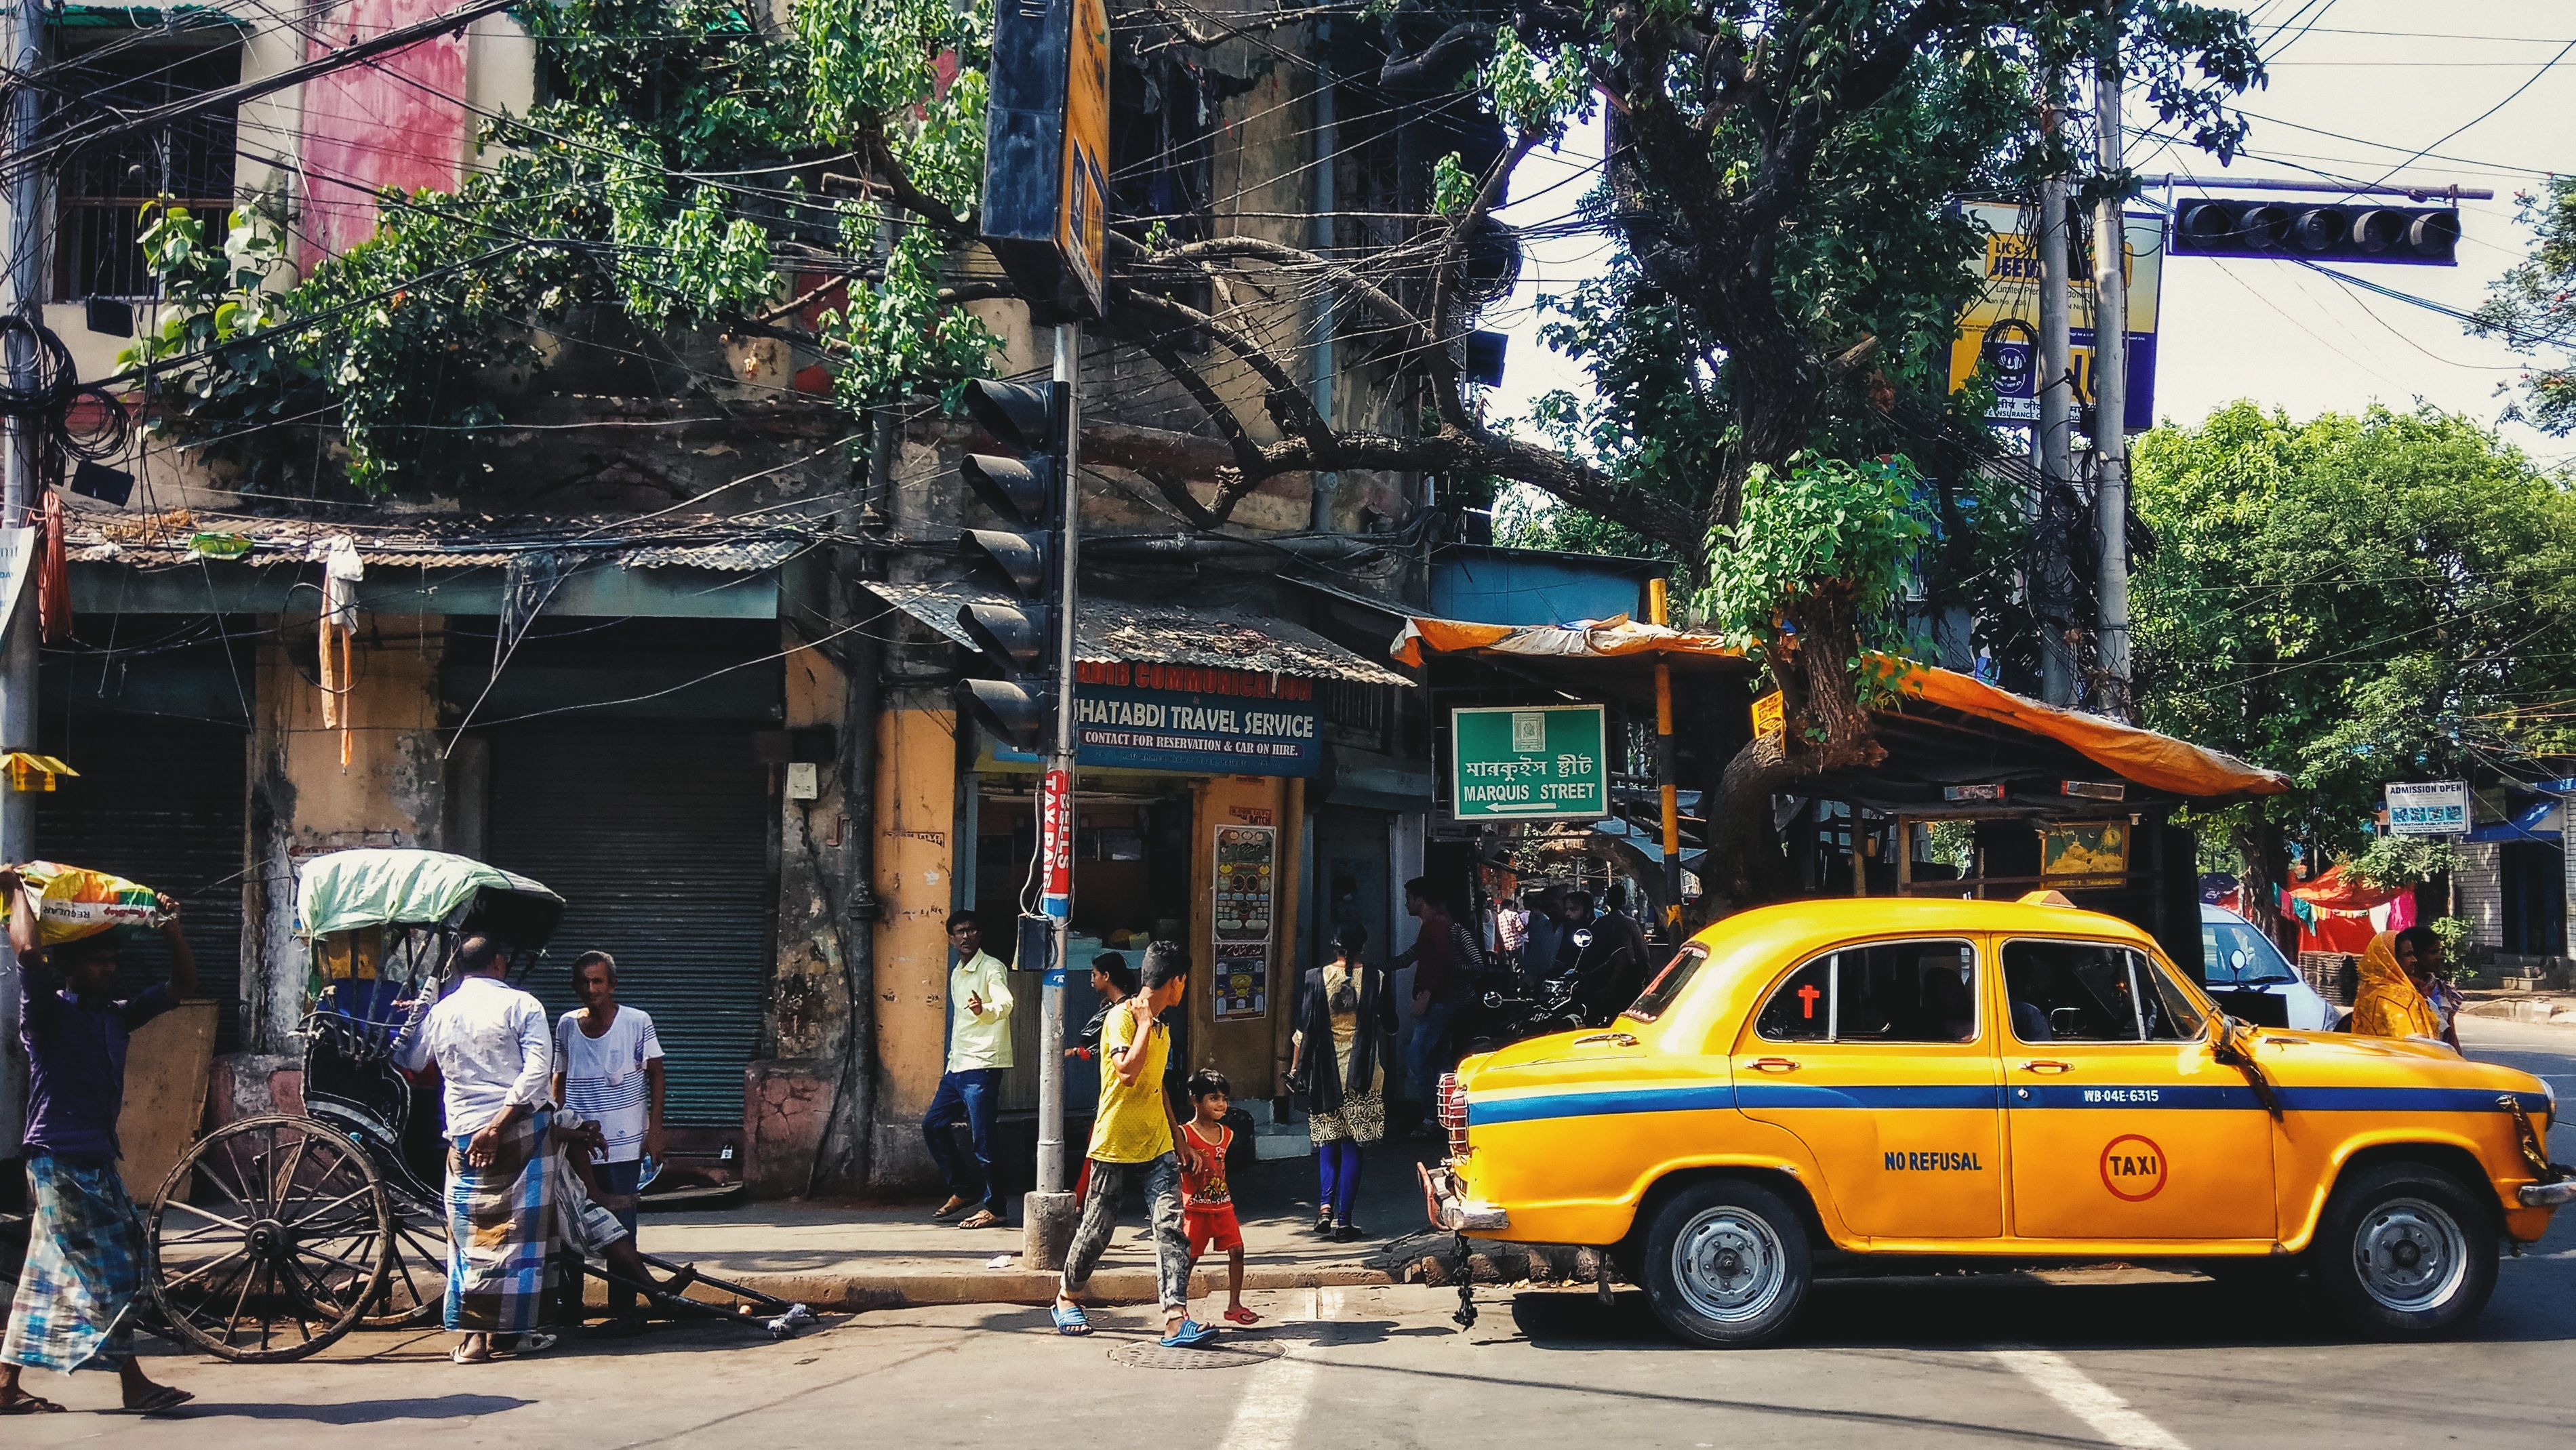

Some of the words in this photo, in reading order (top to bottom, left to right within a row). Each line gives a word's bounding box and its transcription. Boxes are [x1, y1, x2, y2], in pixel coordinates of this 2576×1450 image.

[1990, 256, 2039, 279] JEEV
[1135, 662, 1312, 701] COMMUNICATION
[1171, 706, 1239, 733] TRAVEL
[1244, 712, 1313, 738] SERVICE
[1085, 731, 1130, 745] CONTACT
[1132, 734, 1153, 746] FOR
[1156, 736, 1221, 751] RESERVATION
[1224, 742, 1232, 752] &
[1235, 742, 1254, 753] CAR
[1257, 743, 1270, 754] ON
[1272, 744, 1298, 756] HIRE.
[1466, 754, 1548, 782] মারকুইস
[1045, 775, 1057, 824] TAX
[1464, 785, 1529, 801] MARQUIS
[1540, 783, 1595, 799] STREET
[2390, 785, 2437, 794] ADMISSION
[2439, 784, 2462, 792] OPEN
[43, 906, 90, 919] REGULAR
[1885, 1152, 1906, 1171] NO
[1910, 1152, 1982, 1171] REFUSAL
[2109, 1156, 2157, 1175] TAXI
